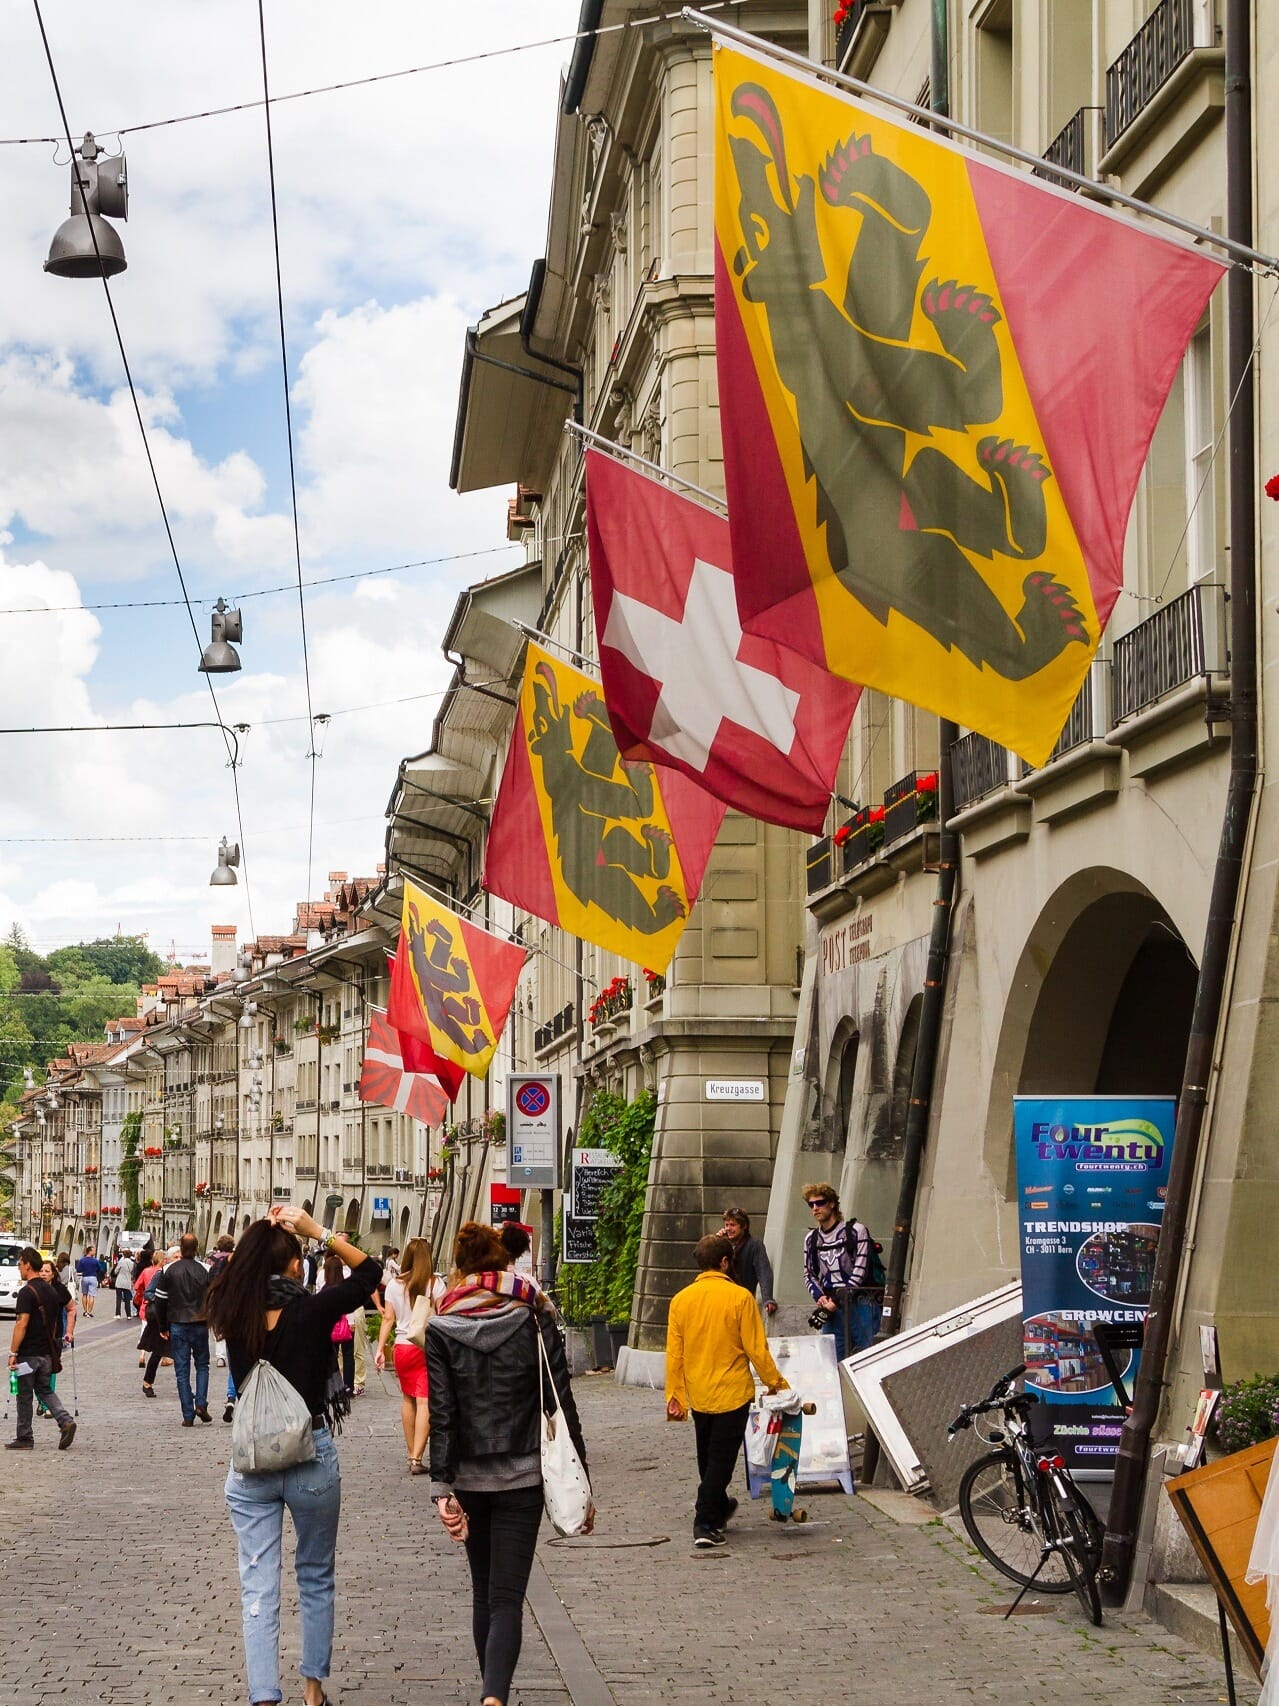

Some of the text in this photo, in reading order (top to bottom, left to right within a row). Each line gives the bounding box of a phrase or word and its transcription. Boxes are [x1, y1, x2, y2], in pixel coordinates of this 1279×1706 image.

[823, 928, 846, 976] POST
[710, 1083, 760, 1097] Kreuzgasse
[1031, 1122, 1110, 1144] Four
[1036, 1142, 1165, 1169] twenty
[1079, 1163, 1144, 1171] fourtwenty.ch
[1024, 1221, 1128, 1233] TRENDSHOP
[1025, 1236, 1067, 1247] Kramgasse 3
[1025, 1245, 1035, 1254] CH
[1040, 1245, 1056, 1254] 3011
[1061, 1310, 1147, 1322] GROWCEN
